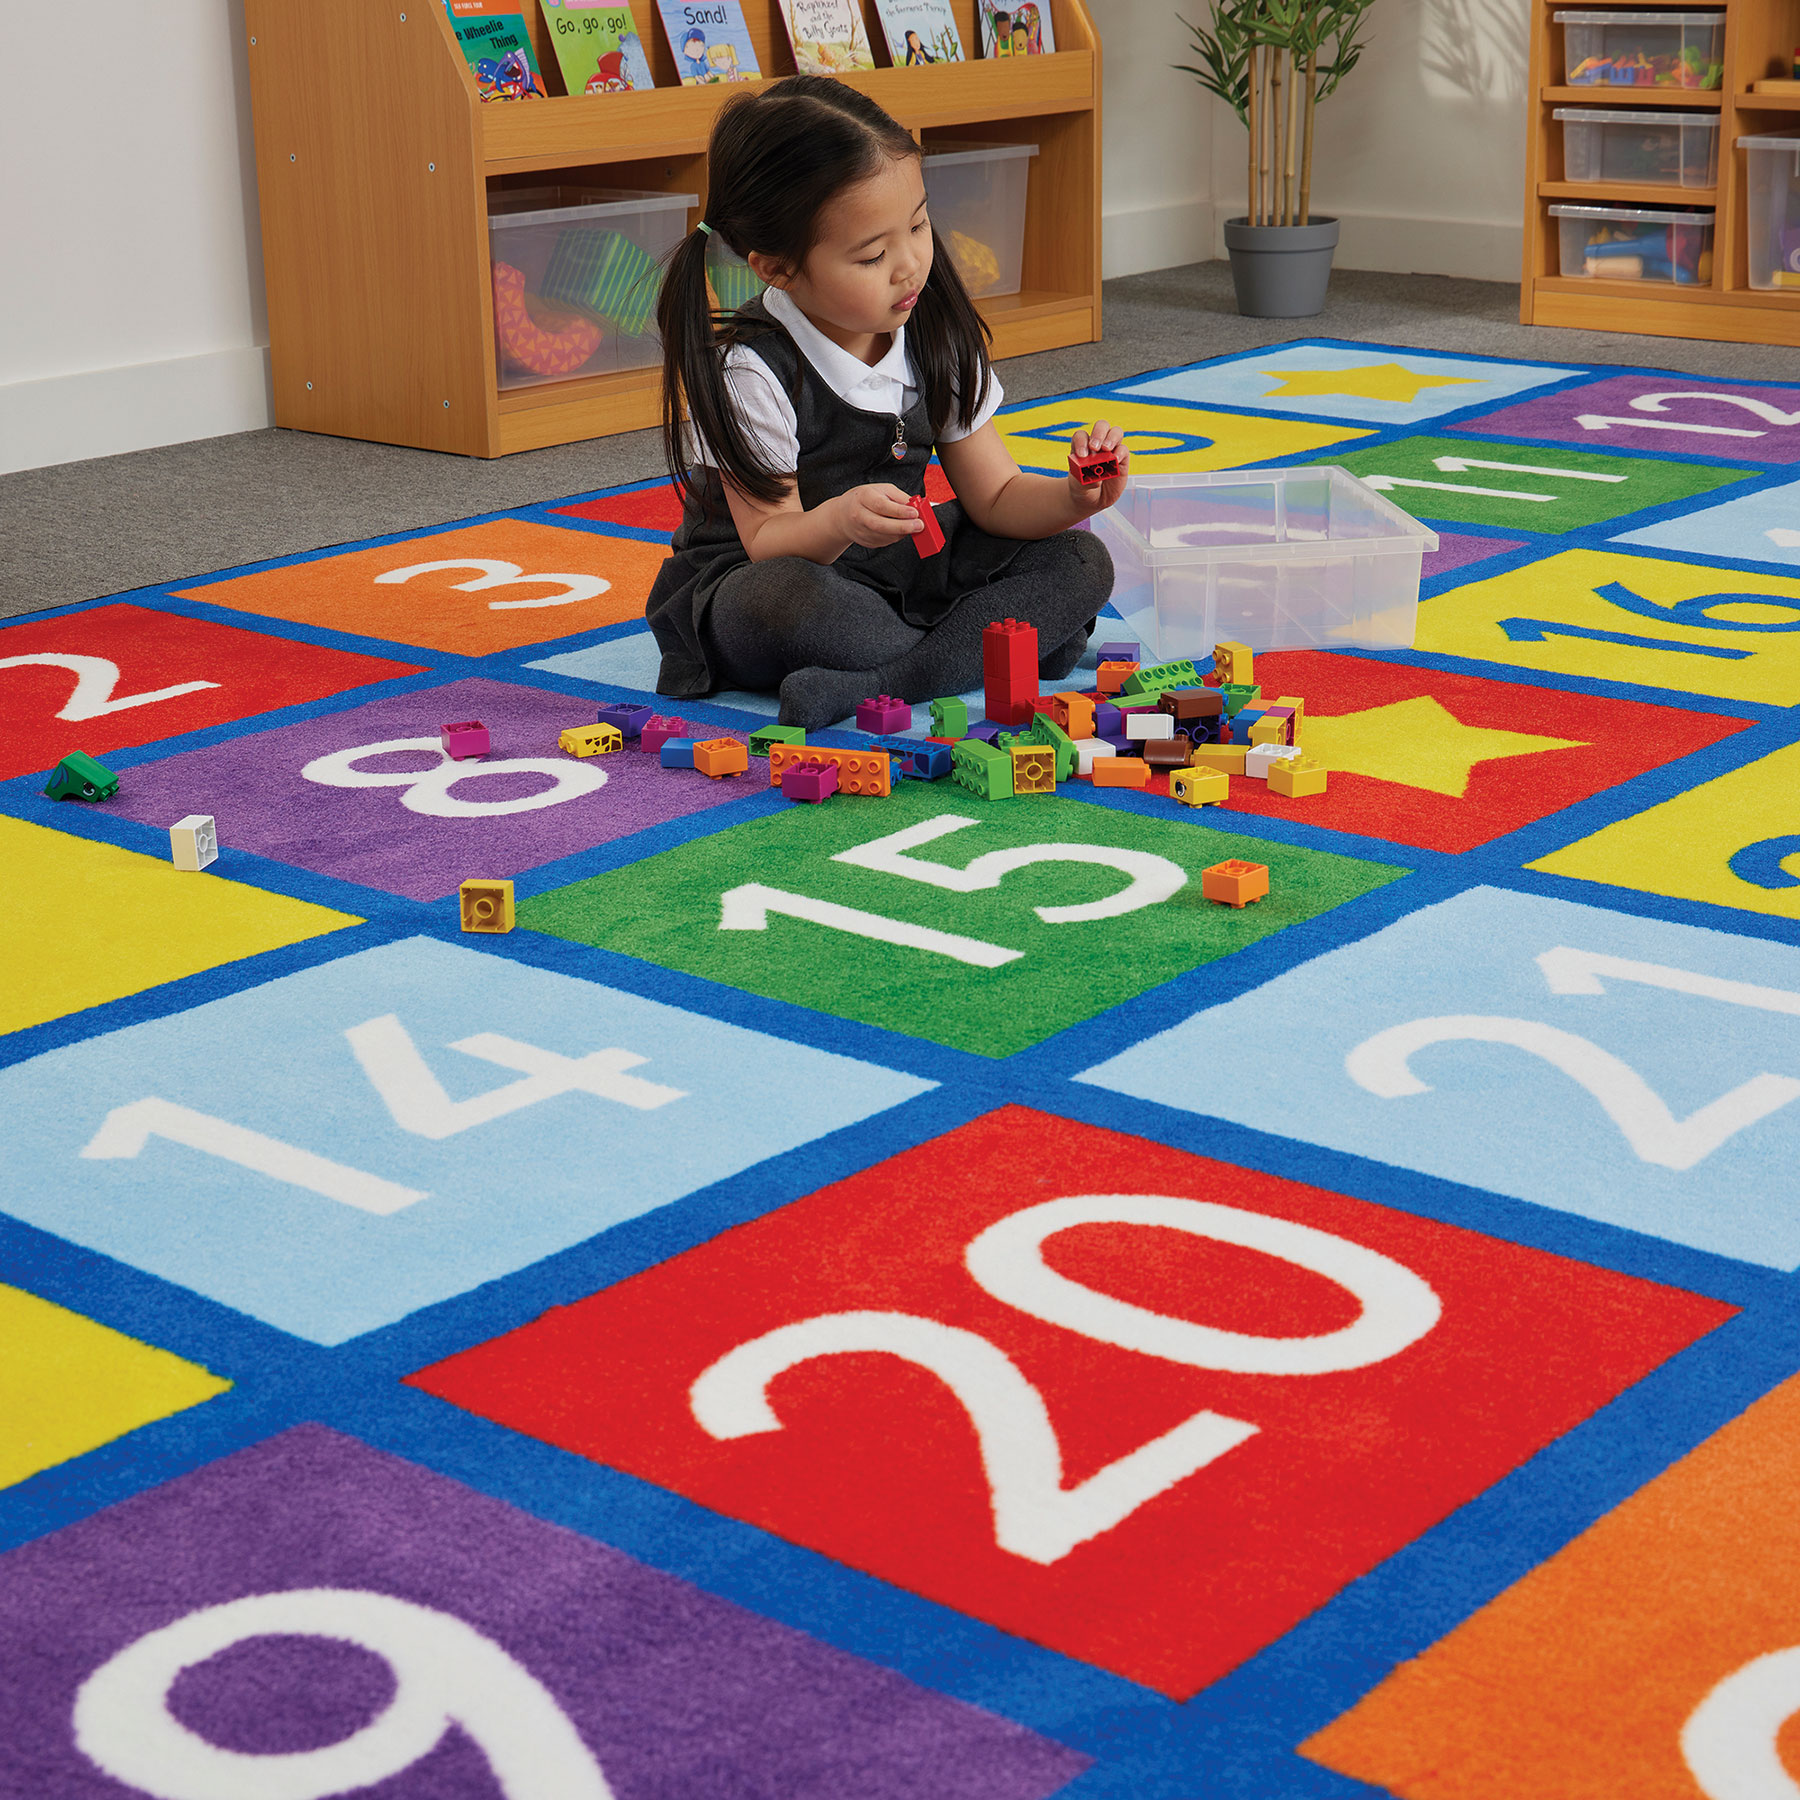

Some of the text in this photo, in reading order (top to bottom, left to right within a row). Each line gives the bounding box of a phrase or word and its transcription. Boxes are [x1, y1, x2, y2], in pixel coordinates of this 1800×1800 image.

[463, 19, 505, 41] Wheelie
[607, 13, 627, 33] go!
[683, 5, 728, 25] Sand!
[802, 20, 849, 39] Billy Goats
[489, 33, 519, 49] Thing
[1006, 421, 1176, 456] 5
[1573, 391, 1800, 437] 12
[1359, 456, 1629, 502] 11
[373, 558, 612, 610] 3
[1496, 581, 1800, 661] 16
[0, 652, 222, 722] 2
[301, 736, 609, 818] 8
[718, 814, 1188, 968] 15
[1344, 945, 1800, 1171] 21
[79, 1012, 691, 1216] 14
[688, 1193, 1442, 1566] 20
